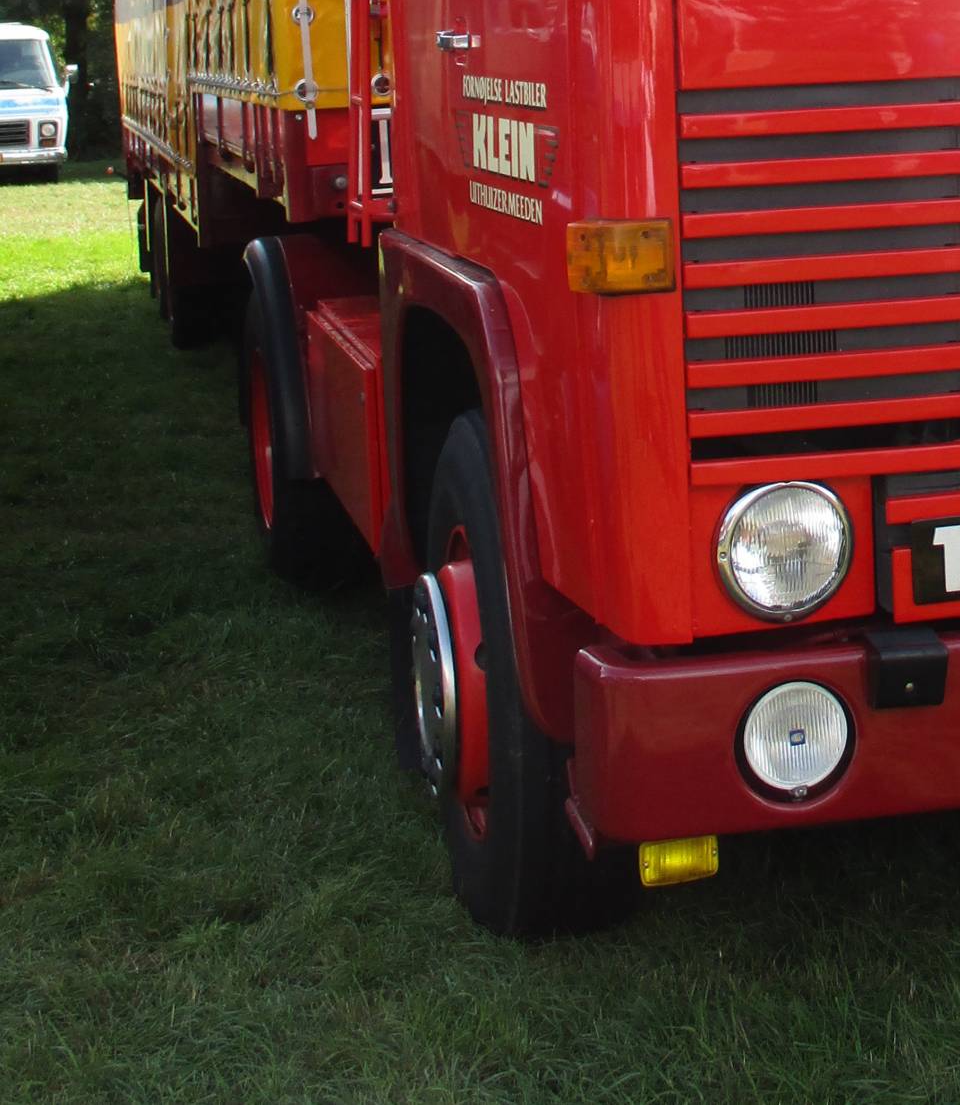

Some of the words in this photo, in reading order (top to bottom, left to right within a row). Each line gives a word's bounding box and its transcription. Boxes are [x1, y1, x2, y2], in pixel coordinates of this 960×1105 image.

[504, 79, 547, 109] LASTBILER
[472, 112, 536, 183] KLEIN
[469, 180, 544, 226] UITHUIZERMEEDEN
